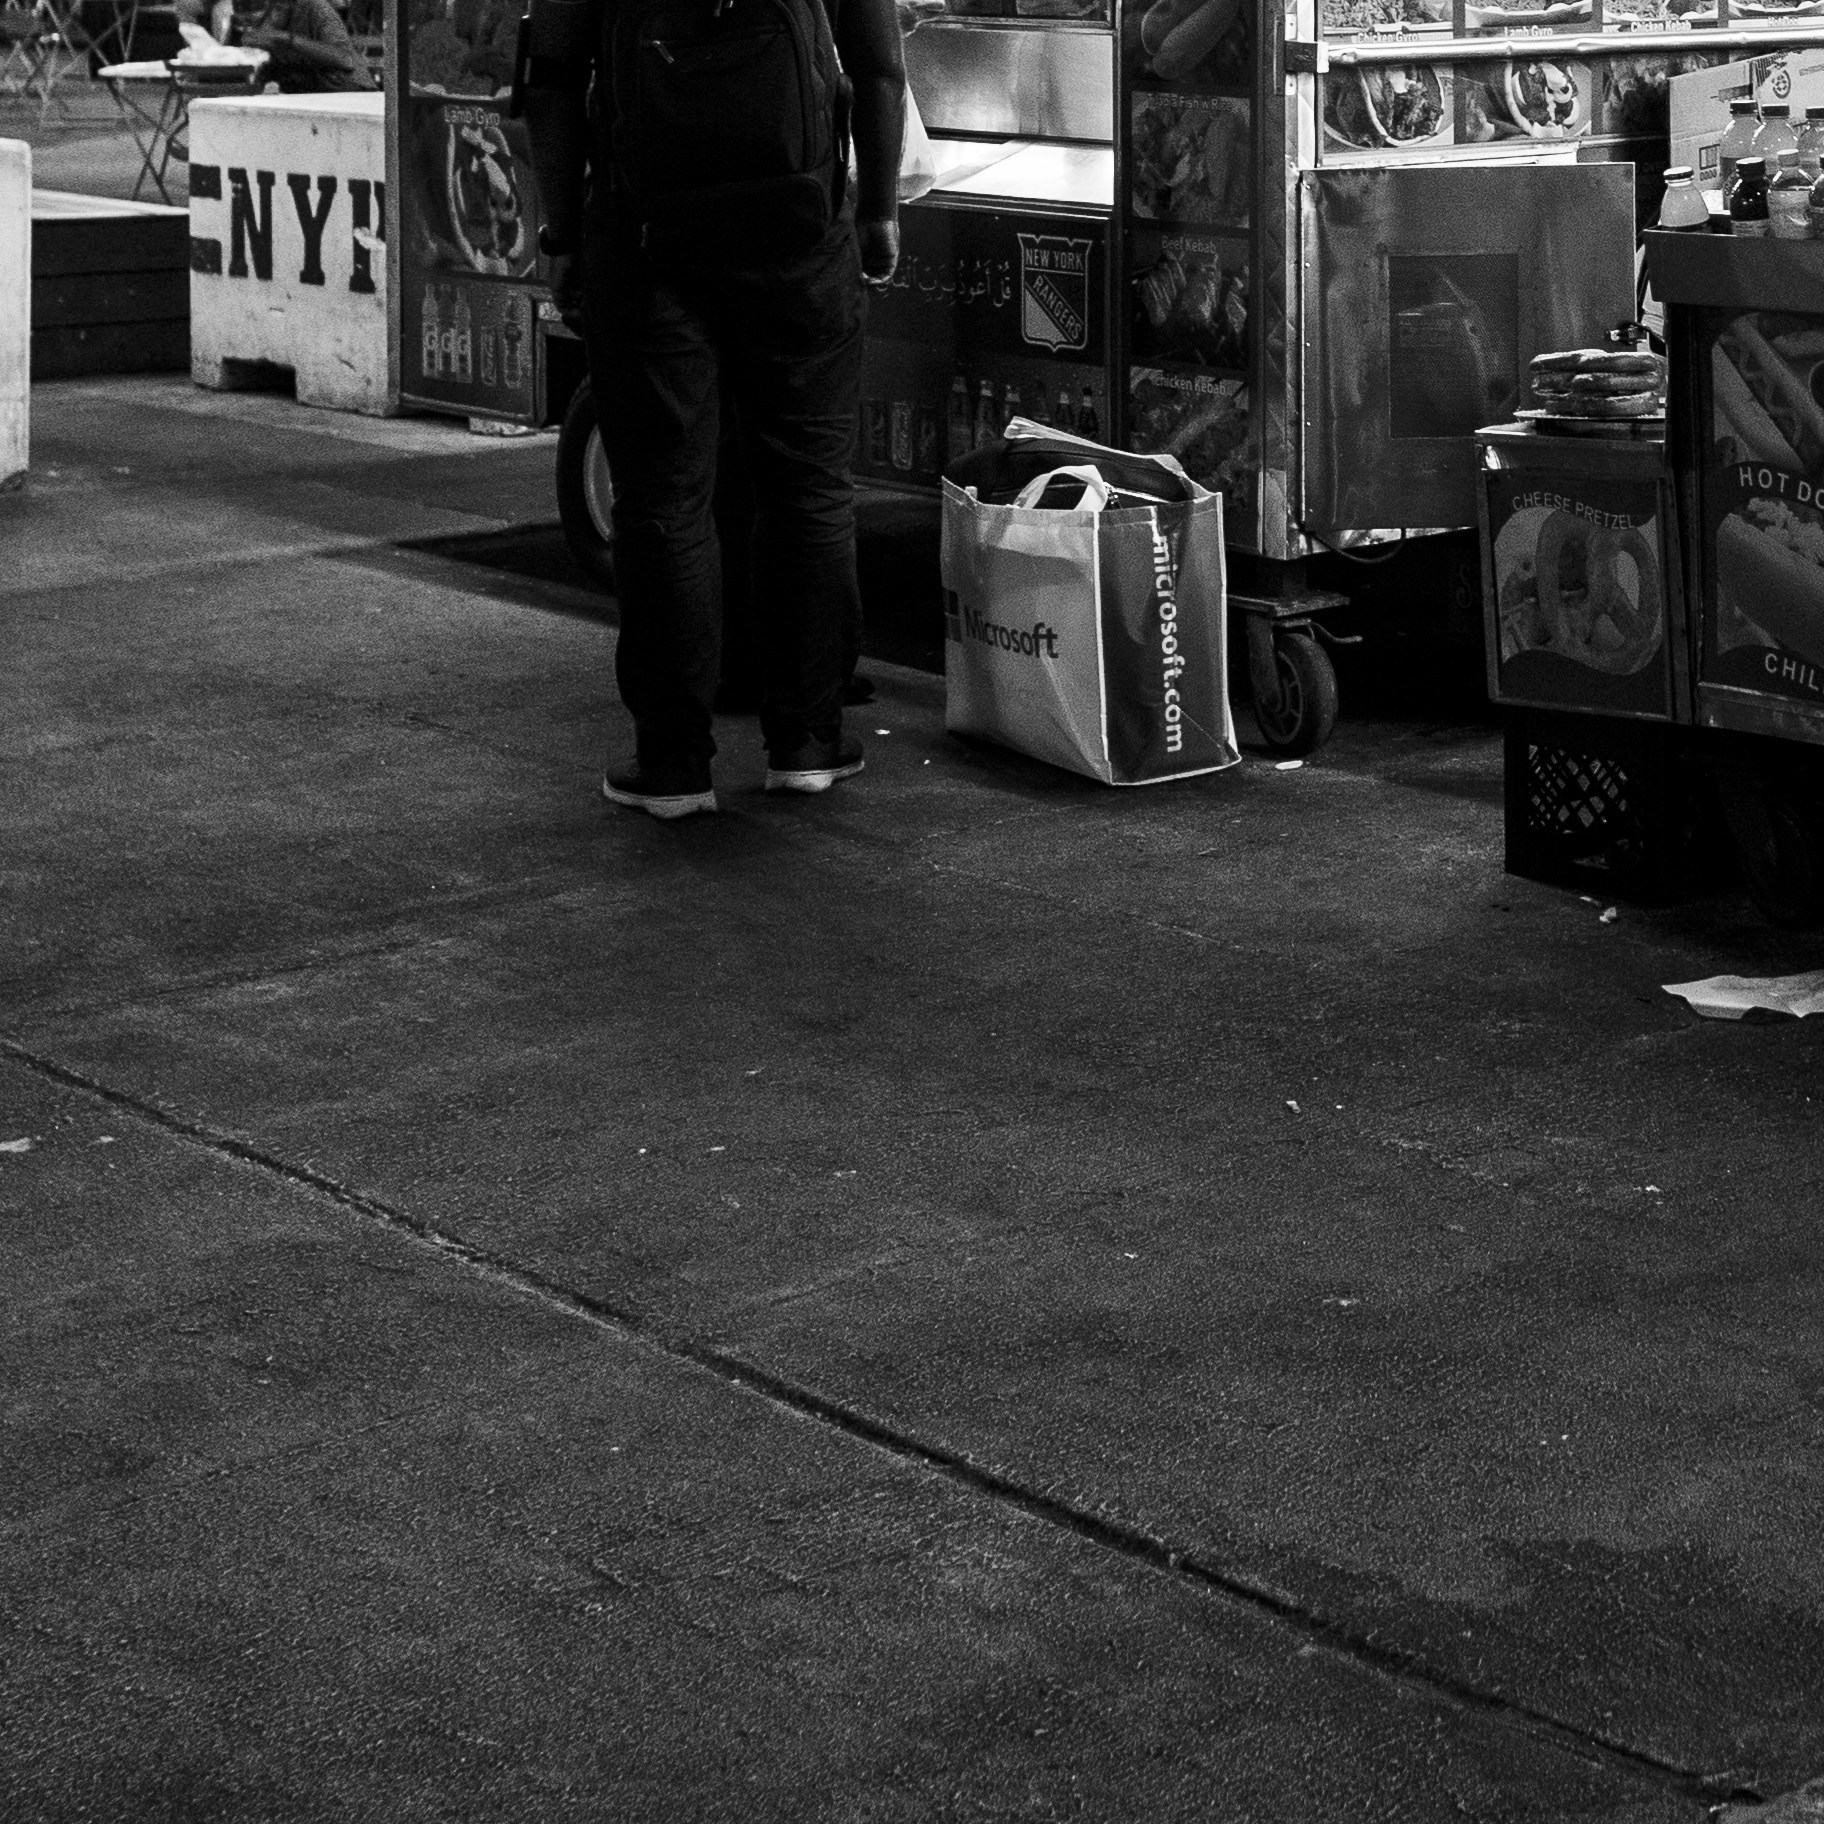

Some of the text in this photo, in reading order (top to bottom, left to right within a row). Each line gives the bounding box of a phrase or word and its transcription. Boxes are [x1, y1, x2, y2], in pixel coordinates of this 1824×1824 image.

[1357, 32, 1394, 44] Chicken
[1504, 25, 1554, 38] Lamb Gyro
[1630, 19, 1692, 33] Chicken Kebab
[474, 106, 501, 130] Gyro
[1025, 248, 1084, 270] NEW YORK
[1032, 274, 1083, 340] RANGERS
[1739, 467, 1790, 494] HOT
[1512, 490, 1636, 530] CHEESE PRETZEL
[964, 603, 1059, 660] Microsoft
[1152, 534, 1186, 754] microsoft.com
